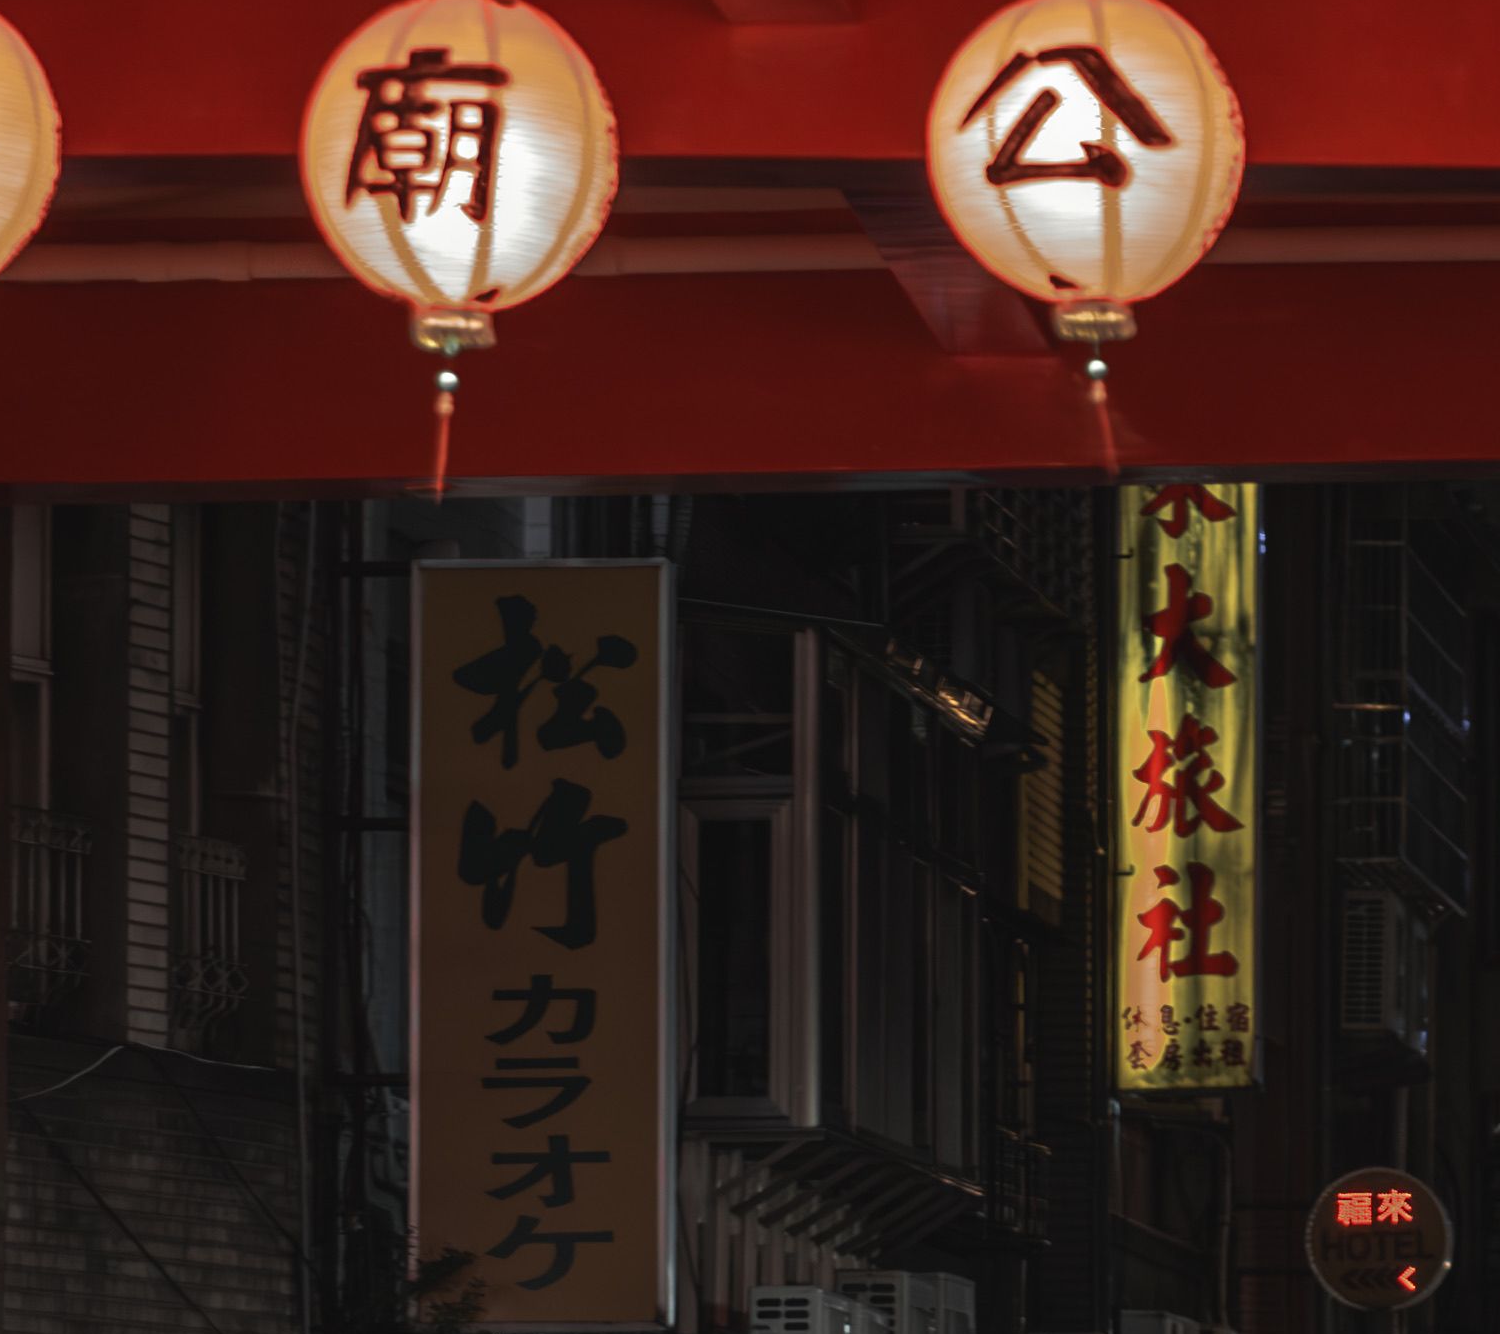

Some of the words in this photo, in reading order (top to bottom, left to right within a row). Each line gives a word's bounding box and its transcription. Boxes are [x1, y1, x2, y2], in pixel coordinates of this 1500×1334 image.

[342, 45, 510, 224] 廟
[955, 44, 1175, 192] 公
[1320, 1229, 1435, 1262] HOTEL
